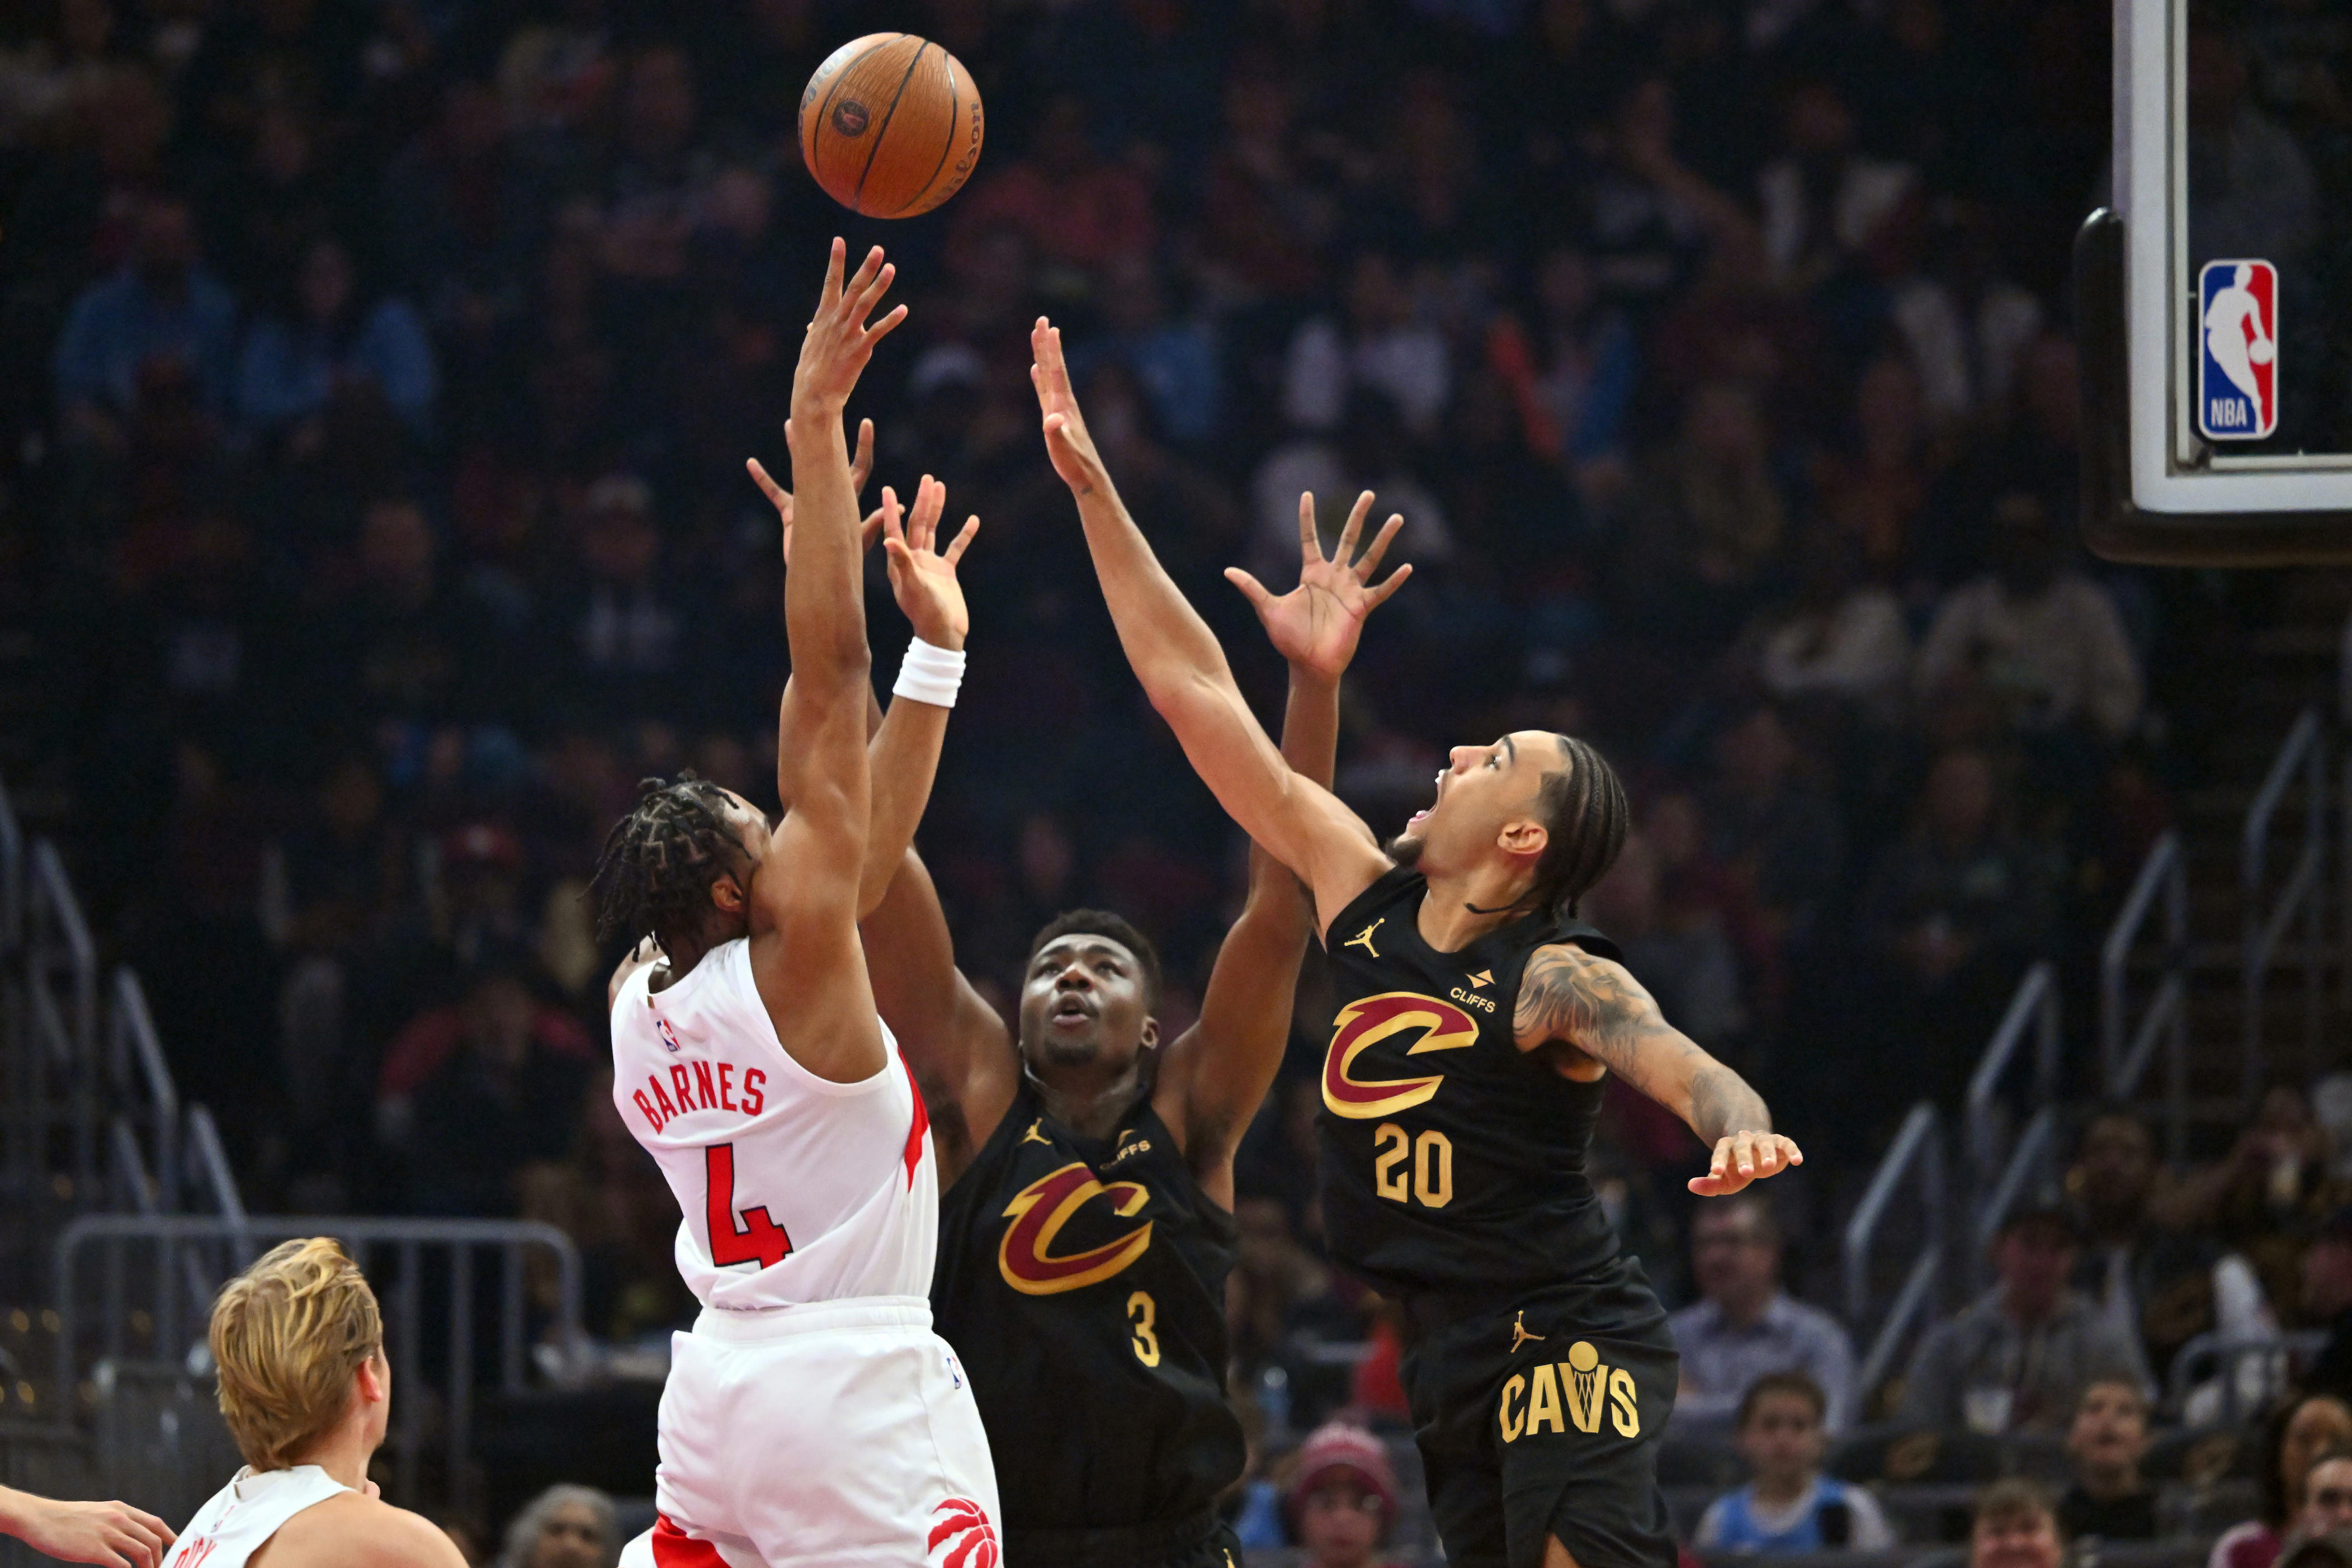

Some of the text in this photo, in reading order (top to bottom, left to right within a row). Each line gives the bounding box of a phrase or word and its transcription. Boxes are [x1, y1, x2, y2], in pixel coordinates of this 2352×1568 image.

[2211, 397, 2247, 427] NBA
[1450, 987, 1495, 1013] CLIFFS
[1321, 991, 1480, 1119] C
[633, 1061, 766, 1135] BARNES
[1375, 1122, 1453, 1208] 20
[706, 1142, 794, 1270] 4
[1127, 1291, 1160, 1367] 3
[1499, 1341, 1640, 1443] CAVS
